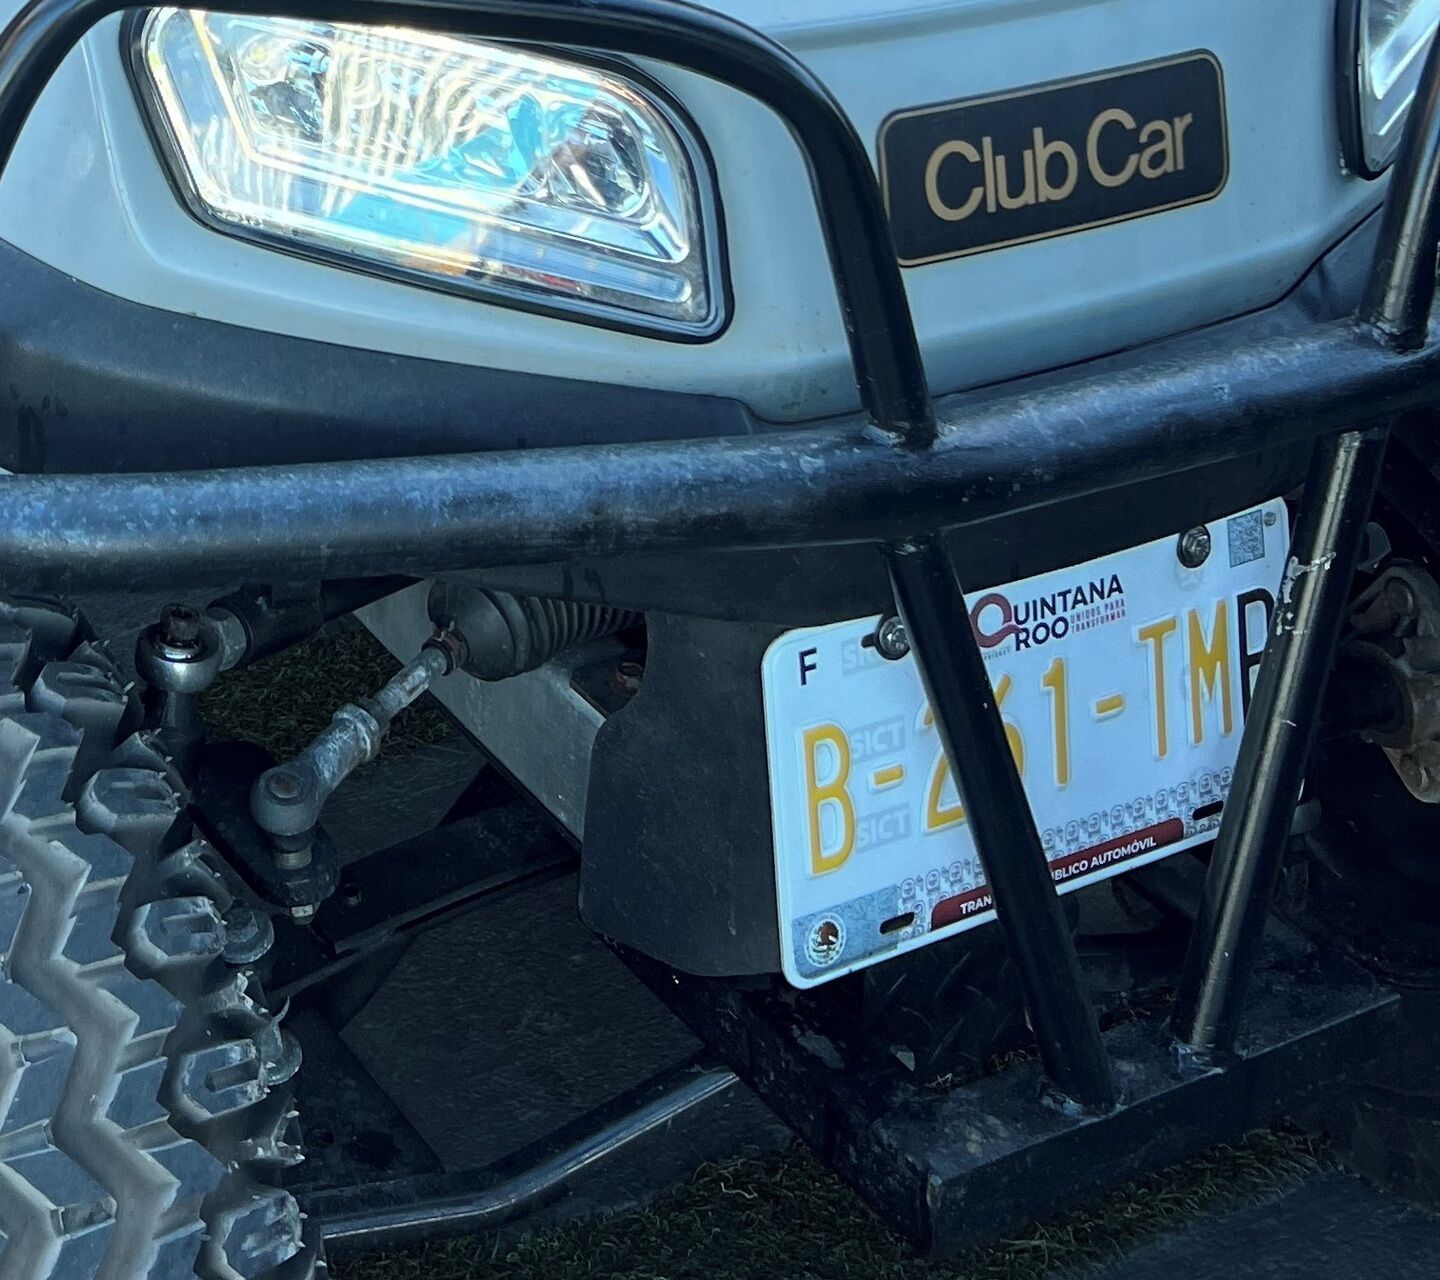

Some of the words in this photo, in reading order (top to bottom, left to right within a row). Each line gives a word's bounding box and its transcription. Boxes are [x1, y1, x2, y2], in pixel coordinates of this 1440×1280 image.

[924, 127, 1079, 222] Club
[1086, 108, 1193, 187] Car
[970, 573, 1124, 648] QUINTANA
[1071, 606, 1101, 624] UNIDOS
[1104, 598, 1125, 613] PARA
[1071, 609, 1126, 634] TRANSFORMAR
[1014, 616, 1070, 652] ROO
[798, 646, 818, 686] F
[1051, 860, 1088, 881] BLICO
[1090, 836, 1157, 868] AUTOMÓVIL
